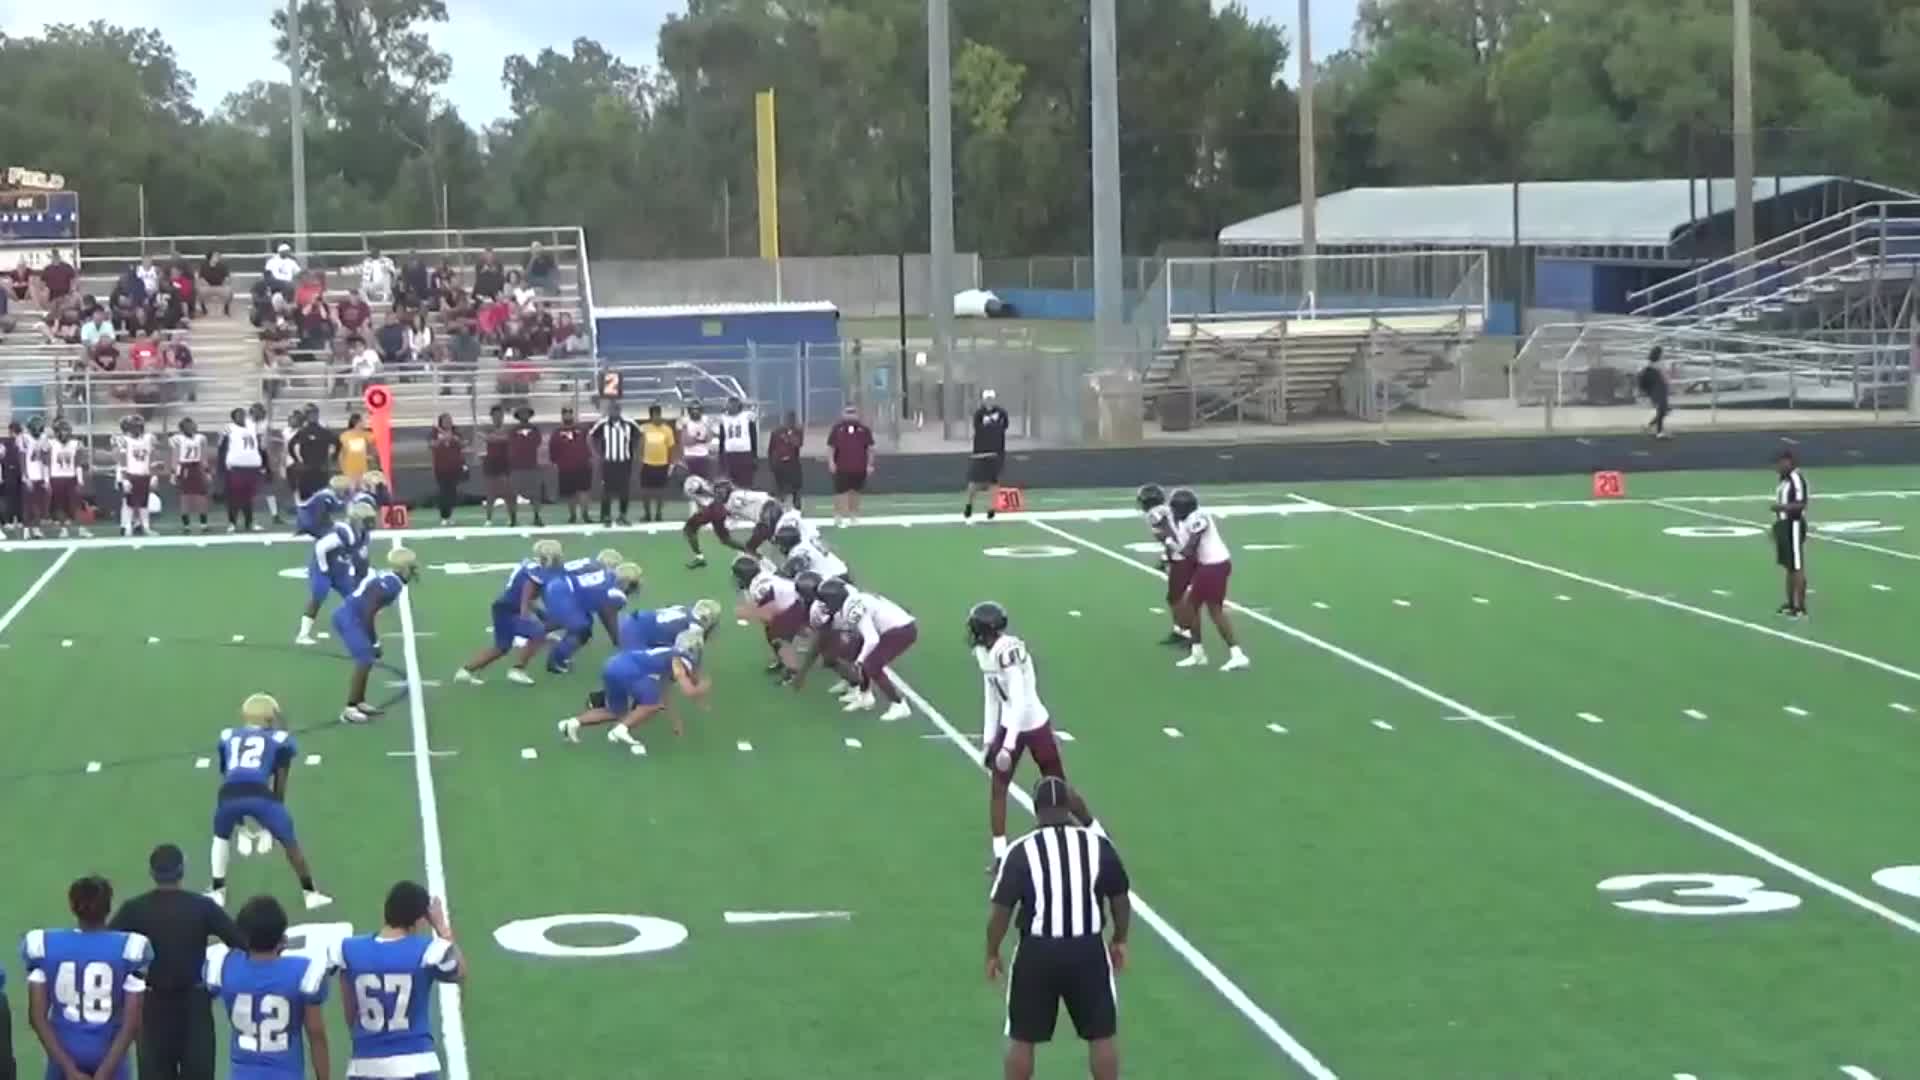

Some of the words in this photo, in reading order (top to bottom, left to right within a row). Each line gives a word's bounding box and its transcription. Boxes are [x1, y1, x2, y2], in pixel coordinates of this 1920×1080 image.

[603, 372, 620, 395] 2
[226, 736, 265, 768] 12
[1596, 873, 1802, 915] 3
[54, 961, 114, 1024] 48
[355, 973, 413, 1033] 67
[231, 994, 290, 1052] 42
